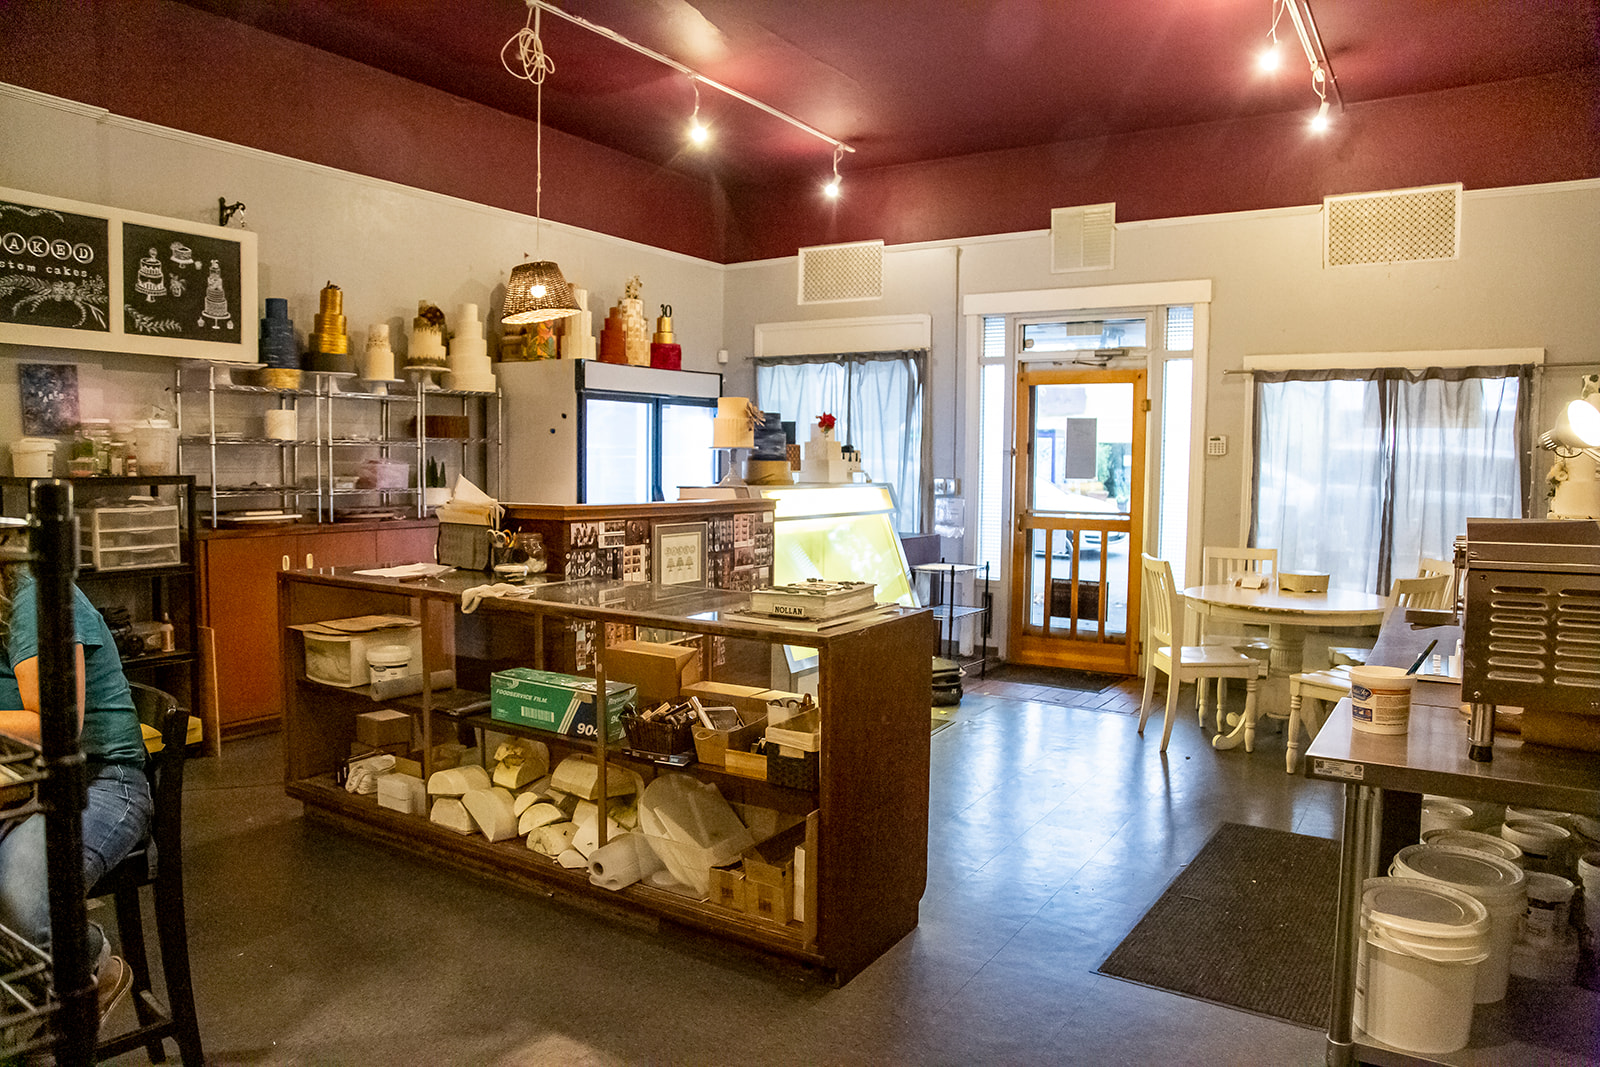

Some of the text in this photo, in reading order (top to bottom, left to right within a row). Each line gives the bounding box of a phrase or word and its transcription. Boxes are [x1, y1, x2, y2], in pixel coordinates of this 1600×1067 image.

[660, 303, 673, 318] 30
[774, 605, 803, 616] NOLLAN
[495, 688, 548, 703] FOODSERVICE FILM
